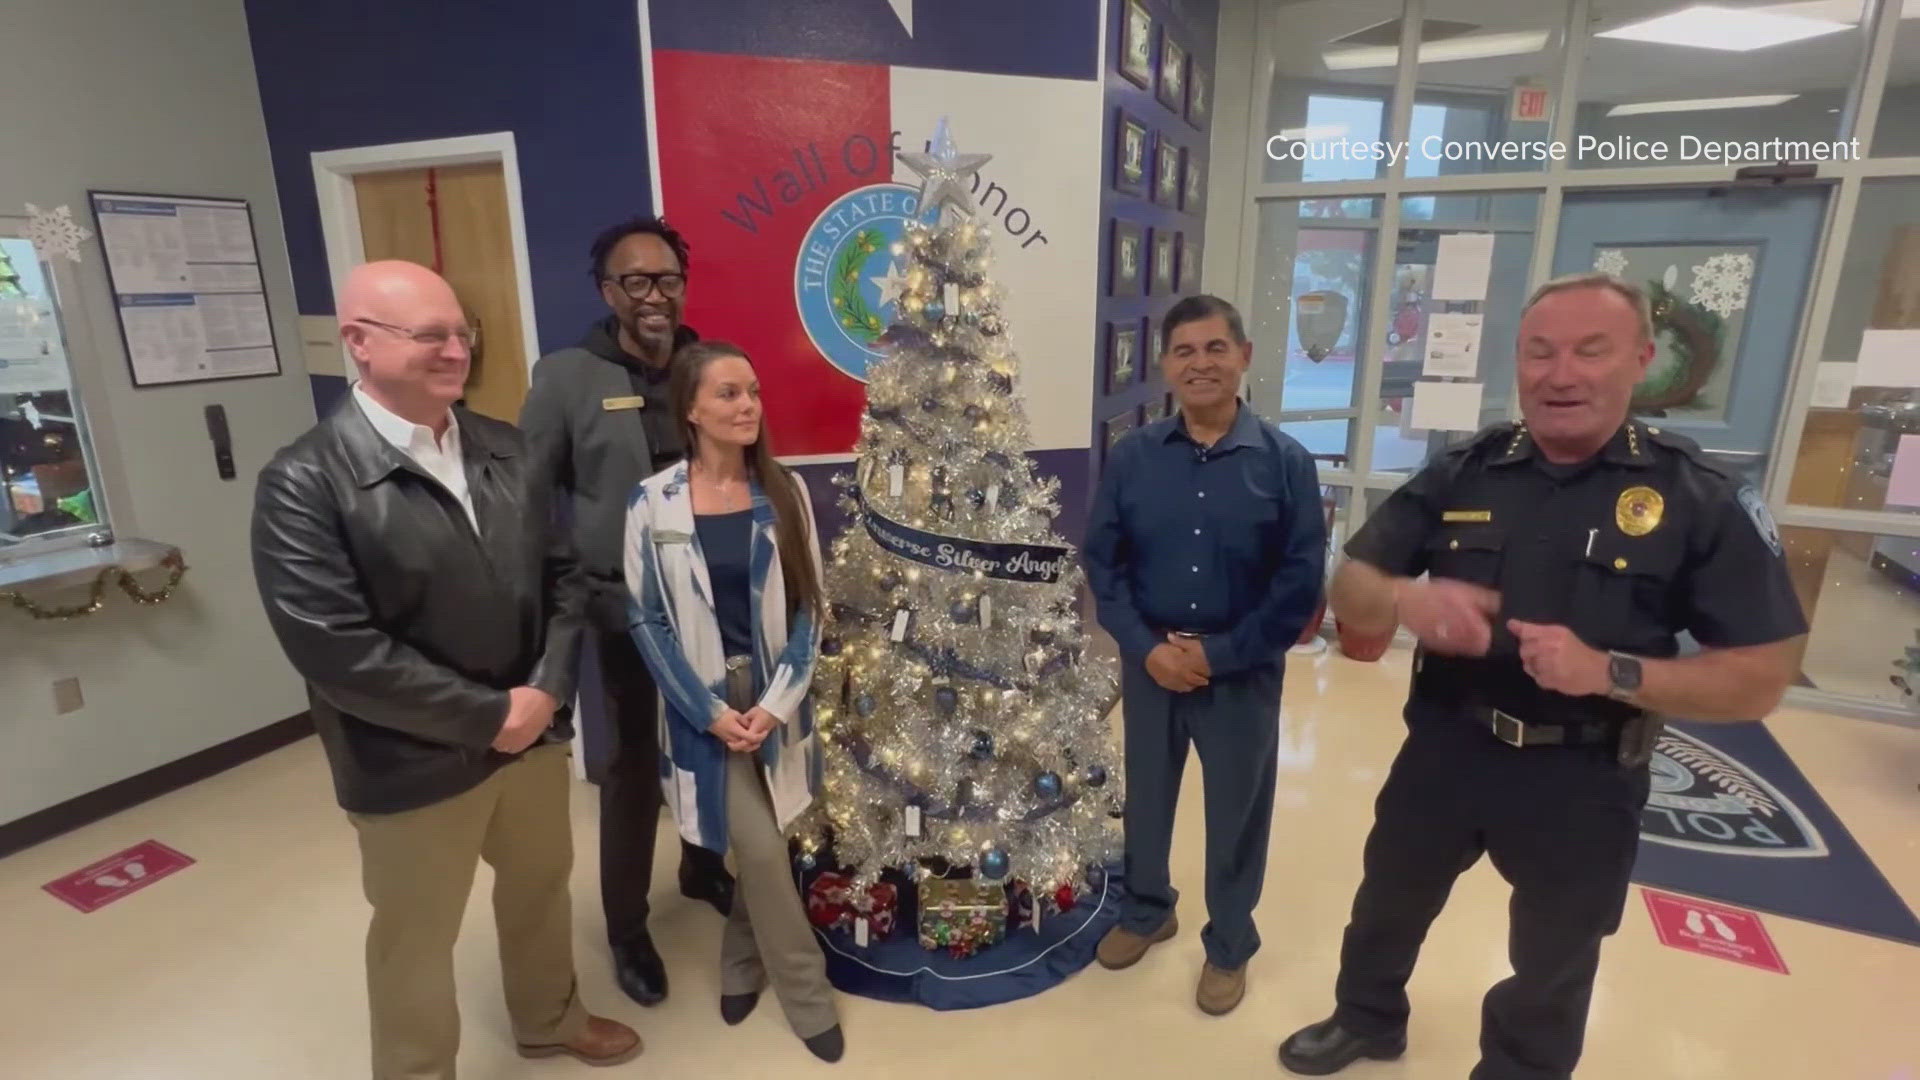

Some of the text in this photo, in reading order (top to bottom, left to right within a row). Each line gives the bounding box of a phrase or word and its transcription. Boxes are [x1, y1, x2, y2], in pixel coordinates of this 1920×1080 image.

[1519, 90, 1548, 117] EXIT
[720, 130, 1048, 249] Wall Of nor
[803, 192, 921, 293] THE STATE O
[934, 543, 1001, 573] Silver
[1640, 805, 1786, 845] POL
